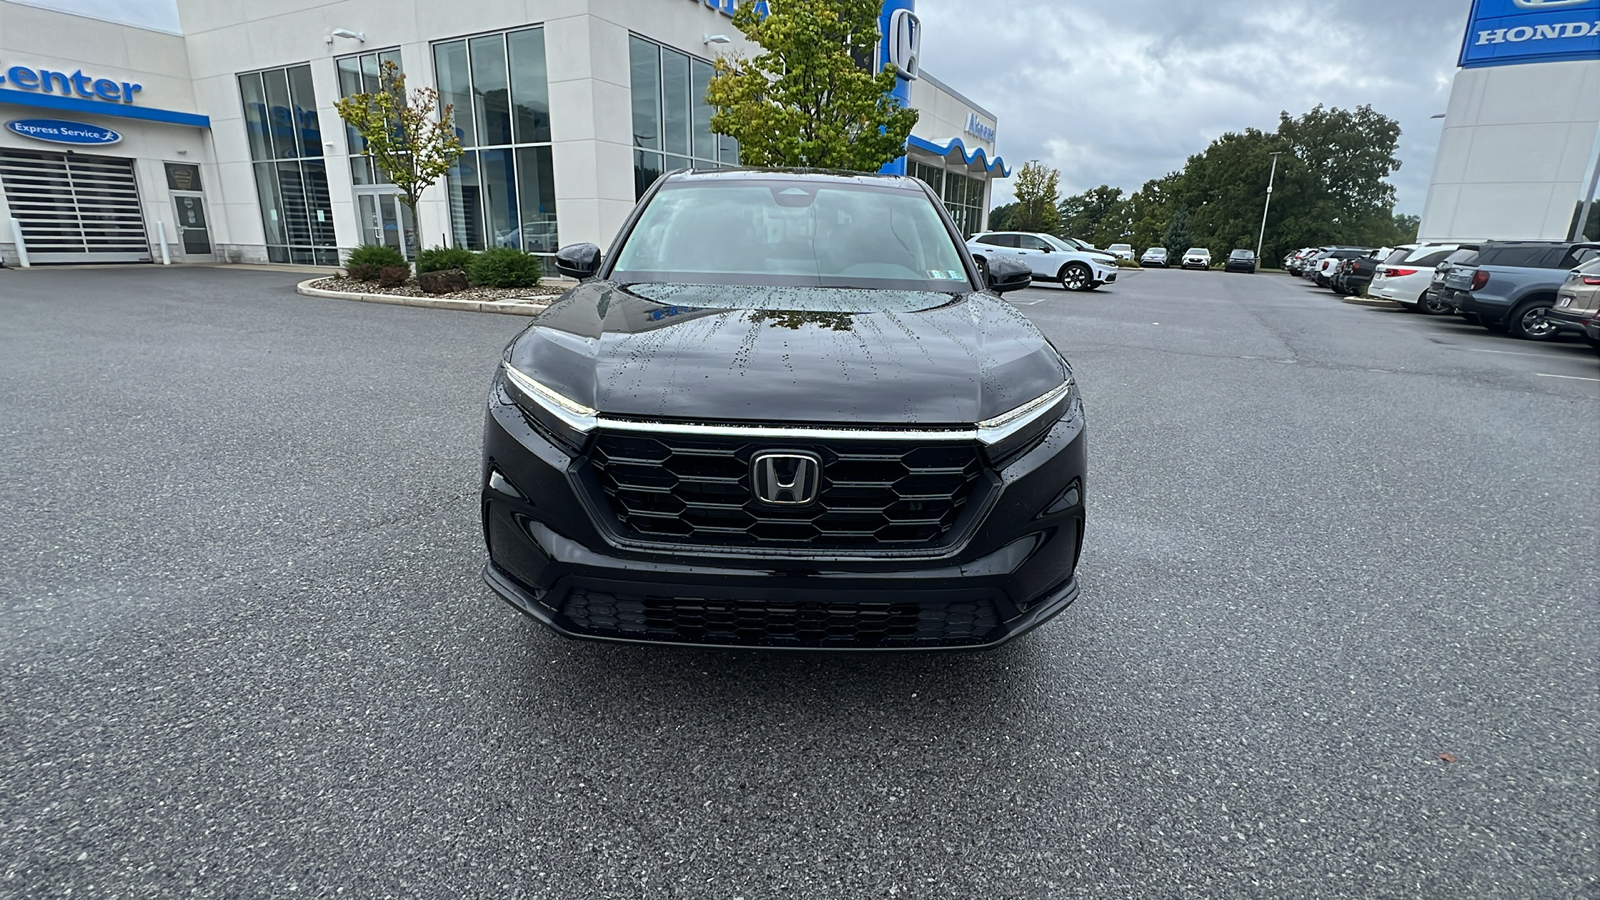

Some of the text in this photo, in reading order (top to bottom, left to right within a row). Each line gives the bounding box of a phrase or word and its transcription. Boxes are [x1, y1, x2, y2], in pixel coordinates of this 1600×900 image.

[0, 65, 142, 103] enter
[14, 122, 100, 139] Express Service
